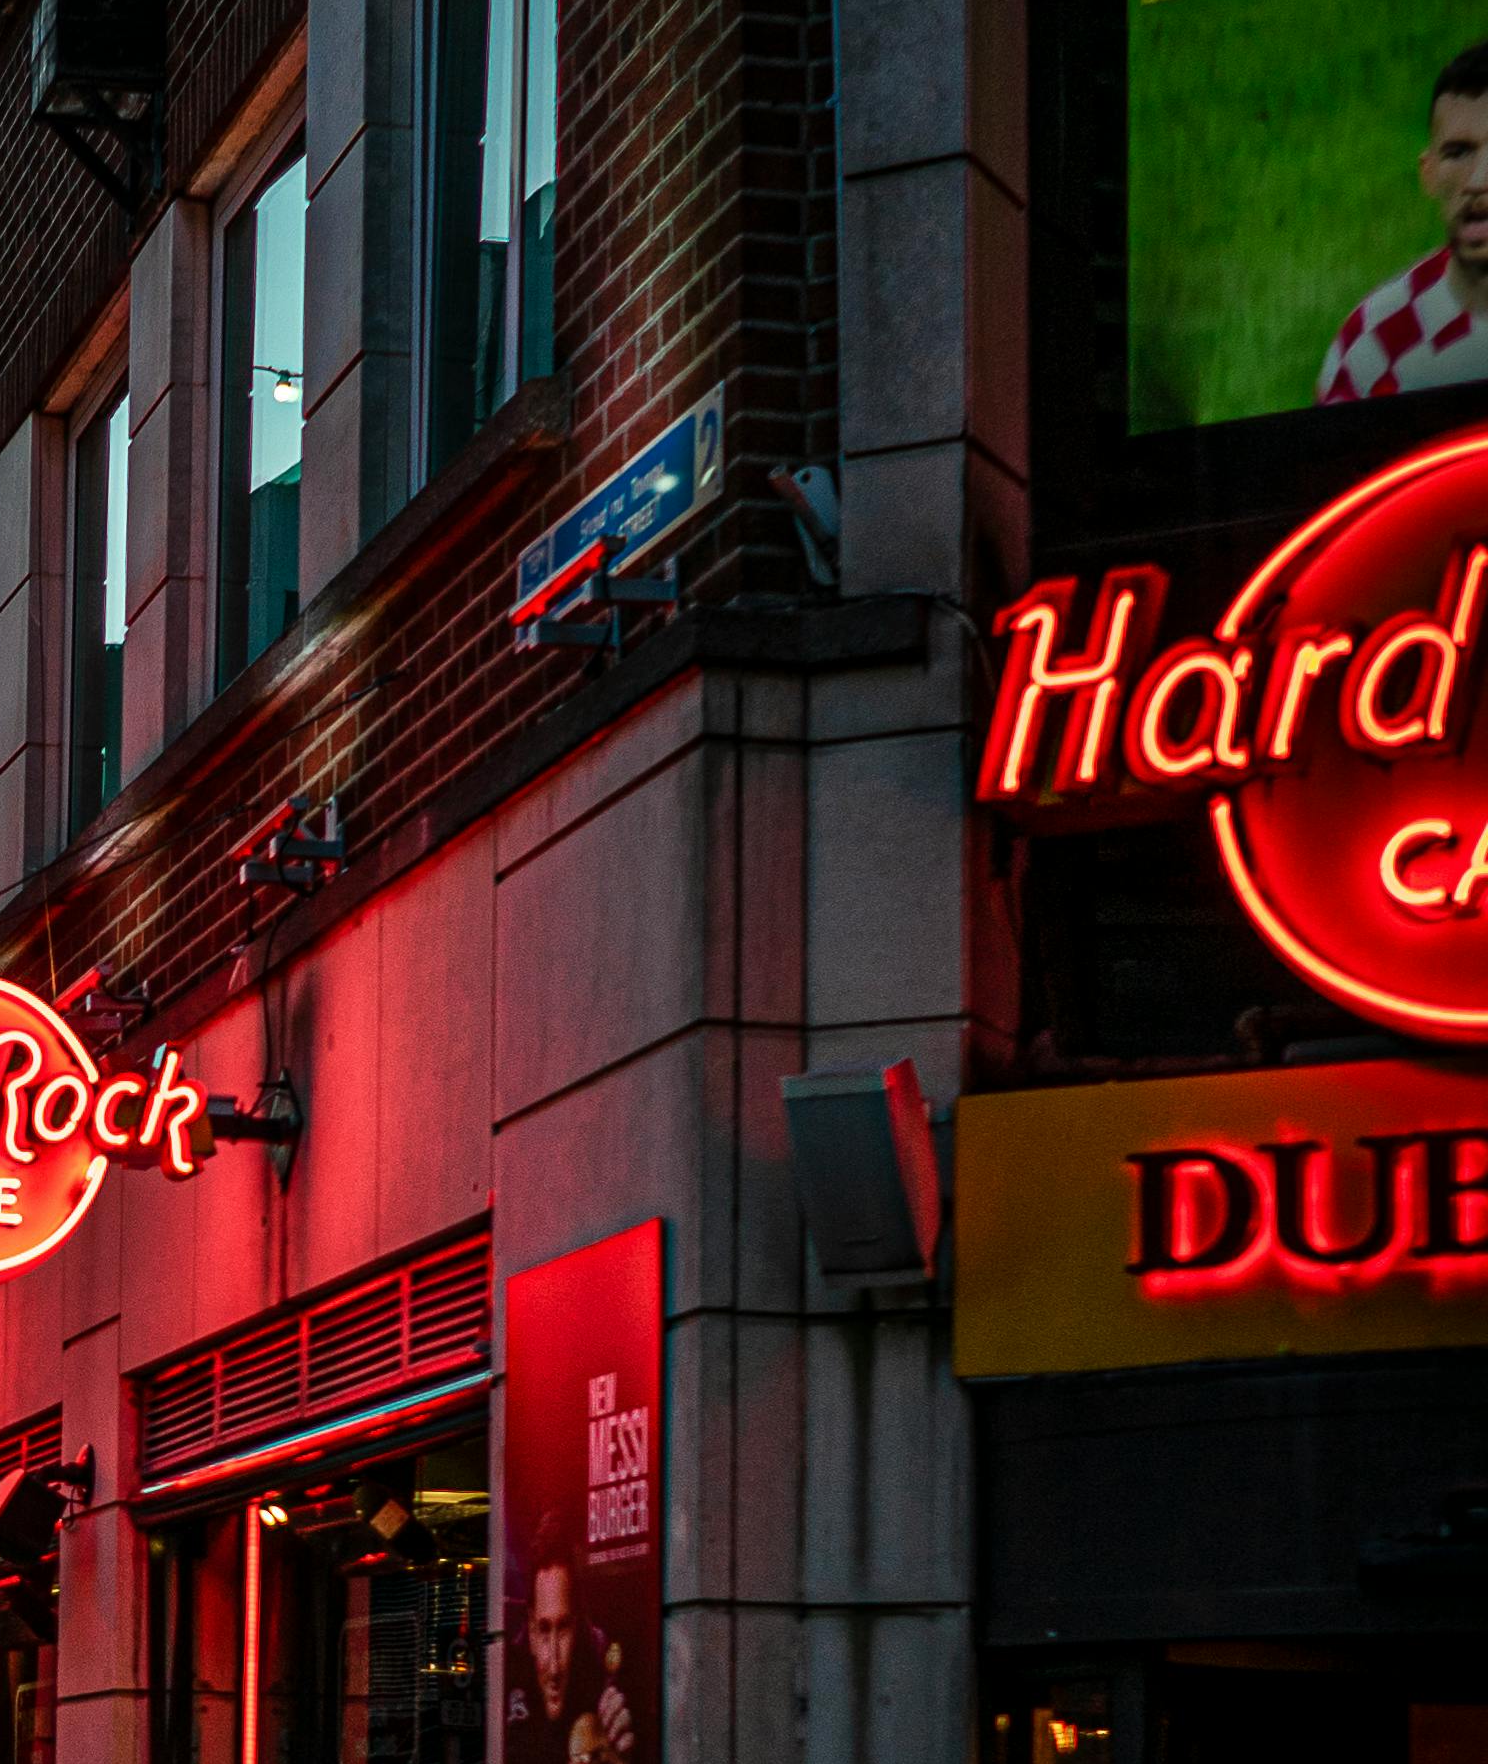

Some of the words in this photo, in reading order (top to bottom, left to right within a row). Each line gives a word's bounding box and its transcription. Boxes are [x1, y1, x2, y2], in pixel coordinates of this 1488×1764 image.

[978, 543, 1488, 799] Hard
[588, 1405, 650, 1488] MESSI
[588, 1478, 650, 1544] BURGER
